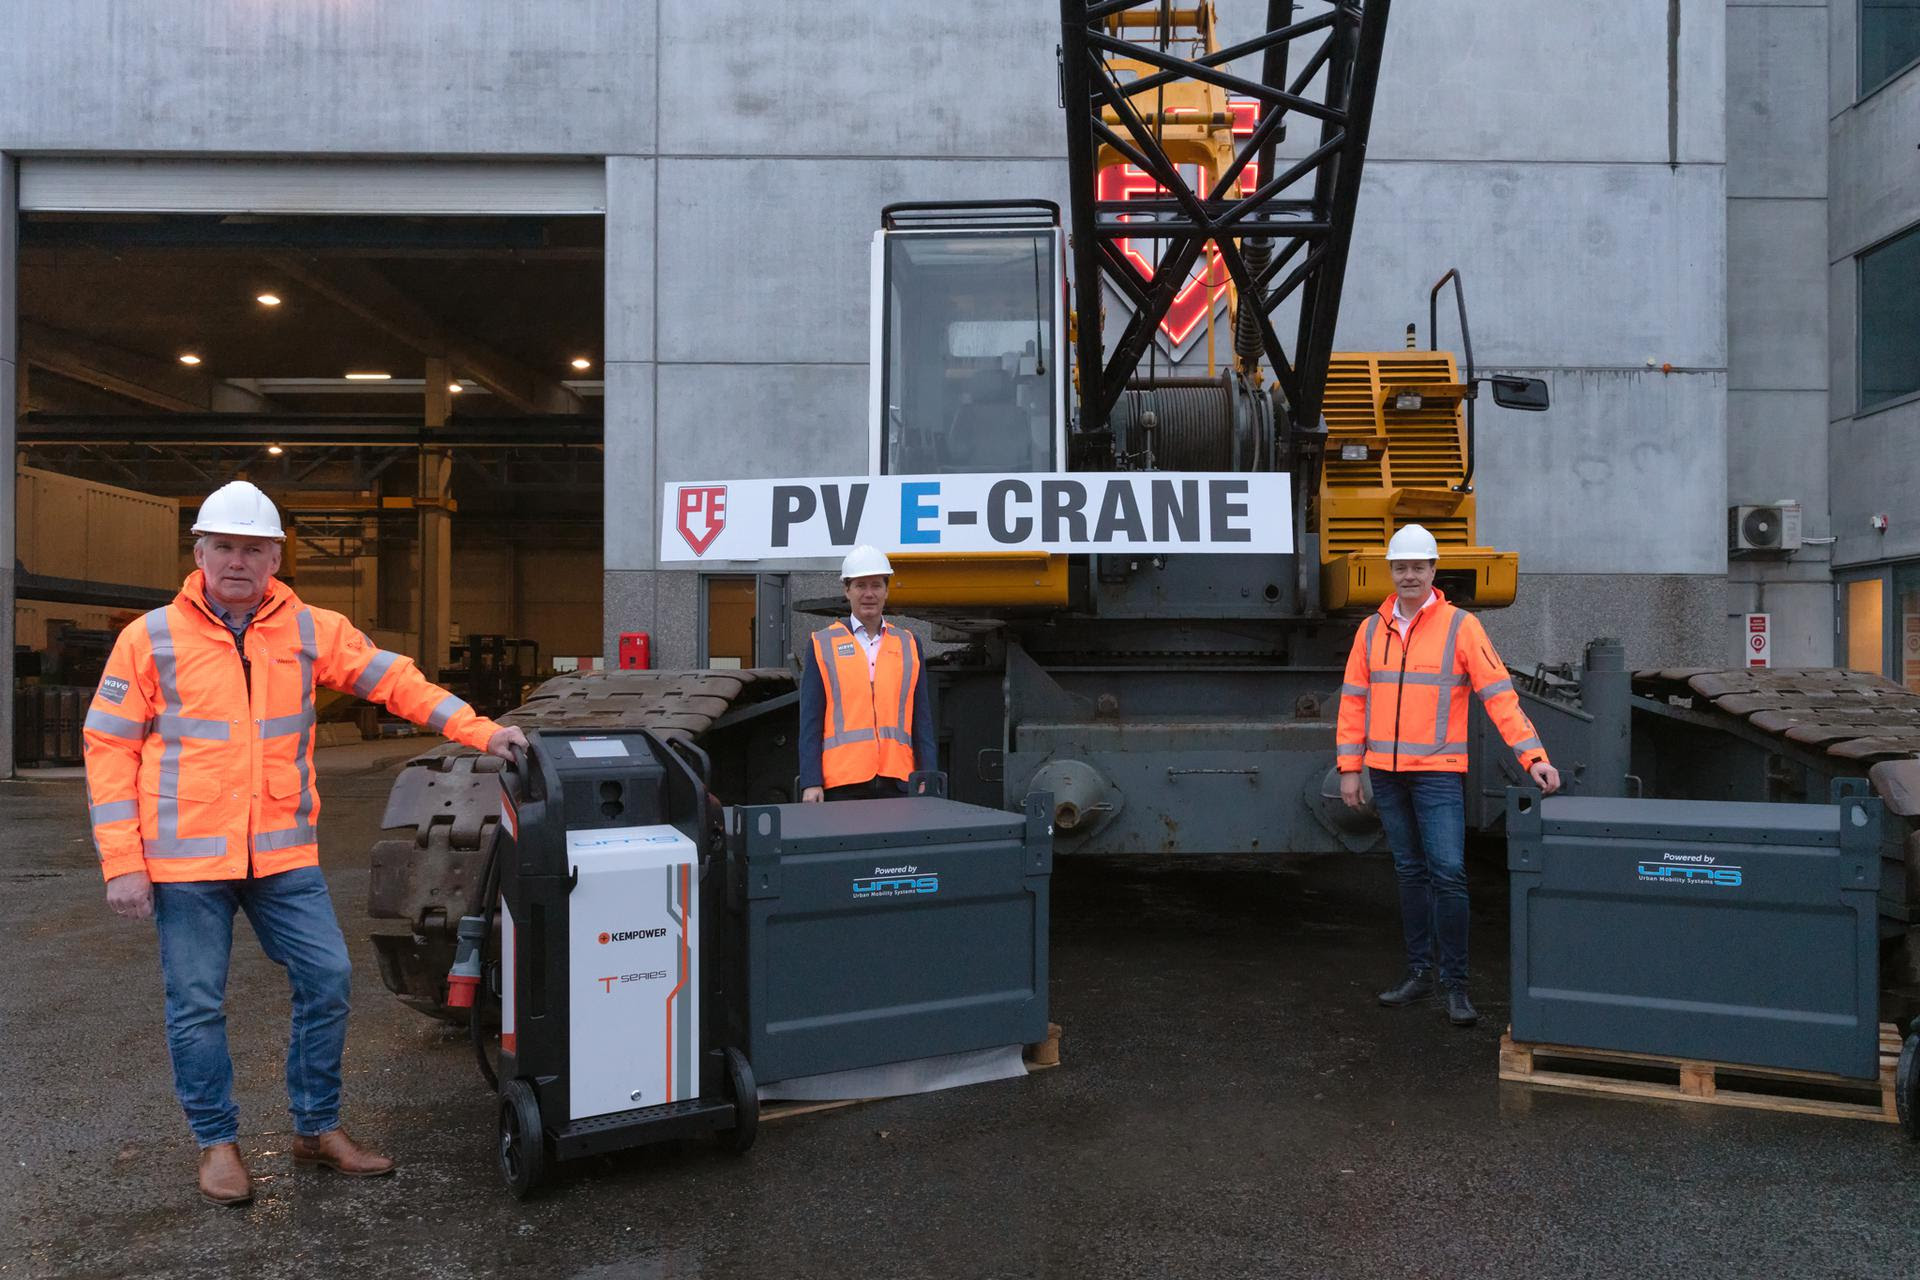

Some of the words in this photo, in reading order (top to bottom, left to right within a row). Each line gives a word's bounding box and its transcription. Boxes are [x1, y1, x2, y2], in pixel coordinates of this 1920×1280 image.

[770, 483, 870, 548] PV
[900, 479, 1252, 544] E-CRANE
[104, 679, 128, 690] wave
[1663, 853, 1702, 862] Powered
[1704, 854, 1715, 864] by
[874, 865, 907, 875] Powered
[907, 865, 917, 874] by
[1659, 876, 1686, 884] Mobility
[1687, 877, 1713, 885] Systems
[611, 928, 666, 942] KEMPOWER
[598, 976, 618, 993] T
